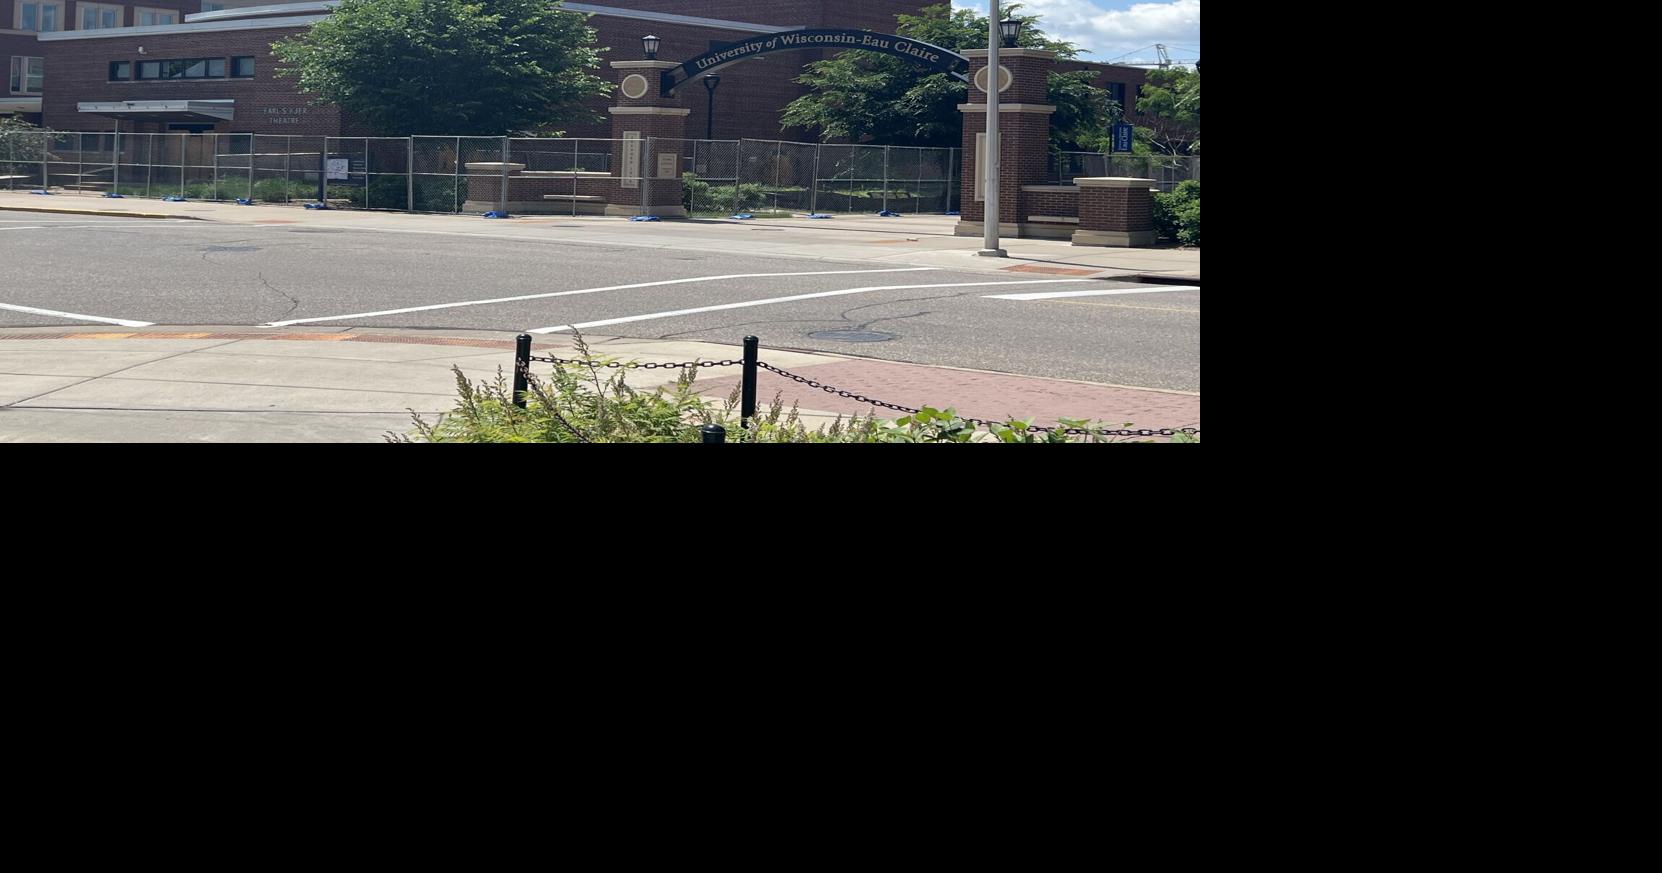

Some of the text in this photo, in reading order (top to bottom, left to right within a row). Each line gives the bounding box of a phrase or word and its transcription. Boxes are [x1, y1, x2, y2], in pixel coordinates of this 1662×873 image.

[695, 32, 940, 70] University of Wisconsin-Eau Claire
